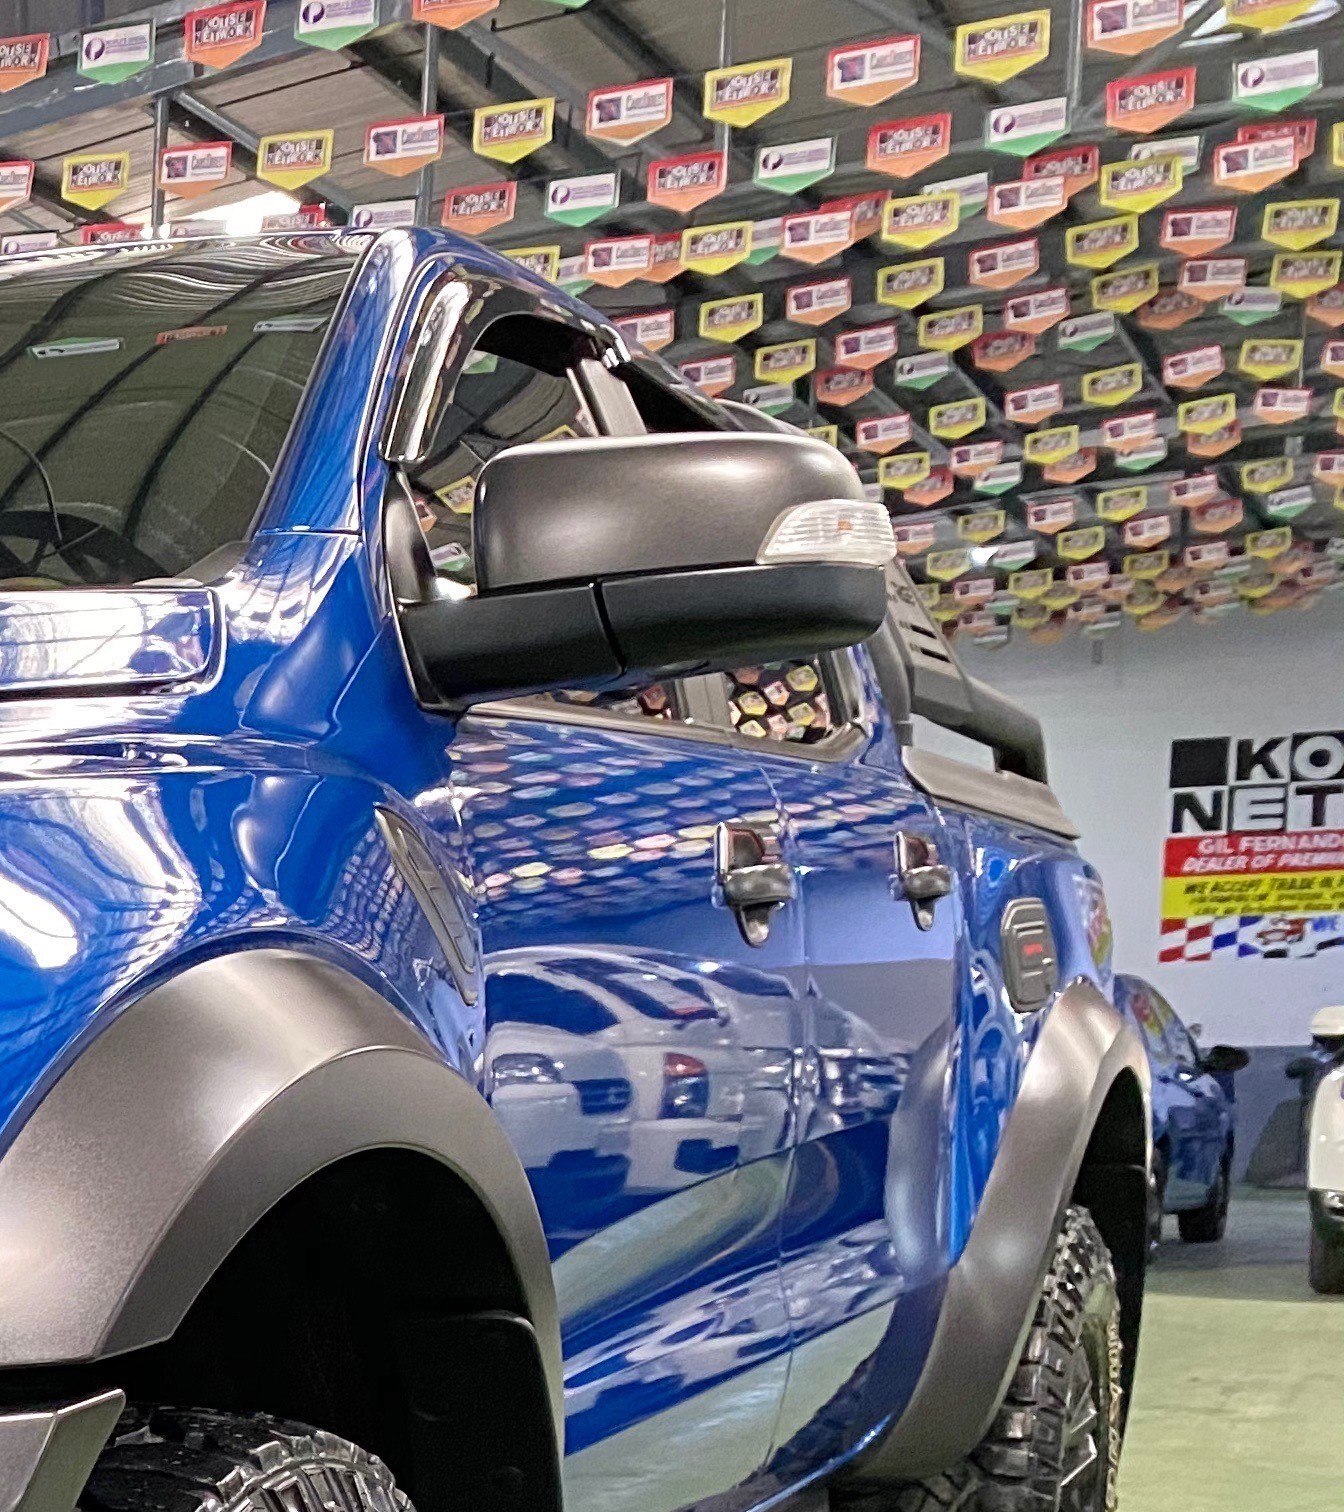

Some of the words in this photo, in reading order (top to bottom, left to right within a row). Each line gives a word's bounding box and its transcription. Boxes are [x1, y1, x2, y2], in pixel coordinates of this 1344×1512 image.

[1172, 784, 1344, 833] NET
[1198, 837, 1236, 855] GIL
[1182, 855, 1250, 873] DEALER
[1250, 854, 1276, 870] OF
